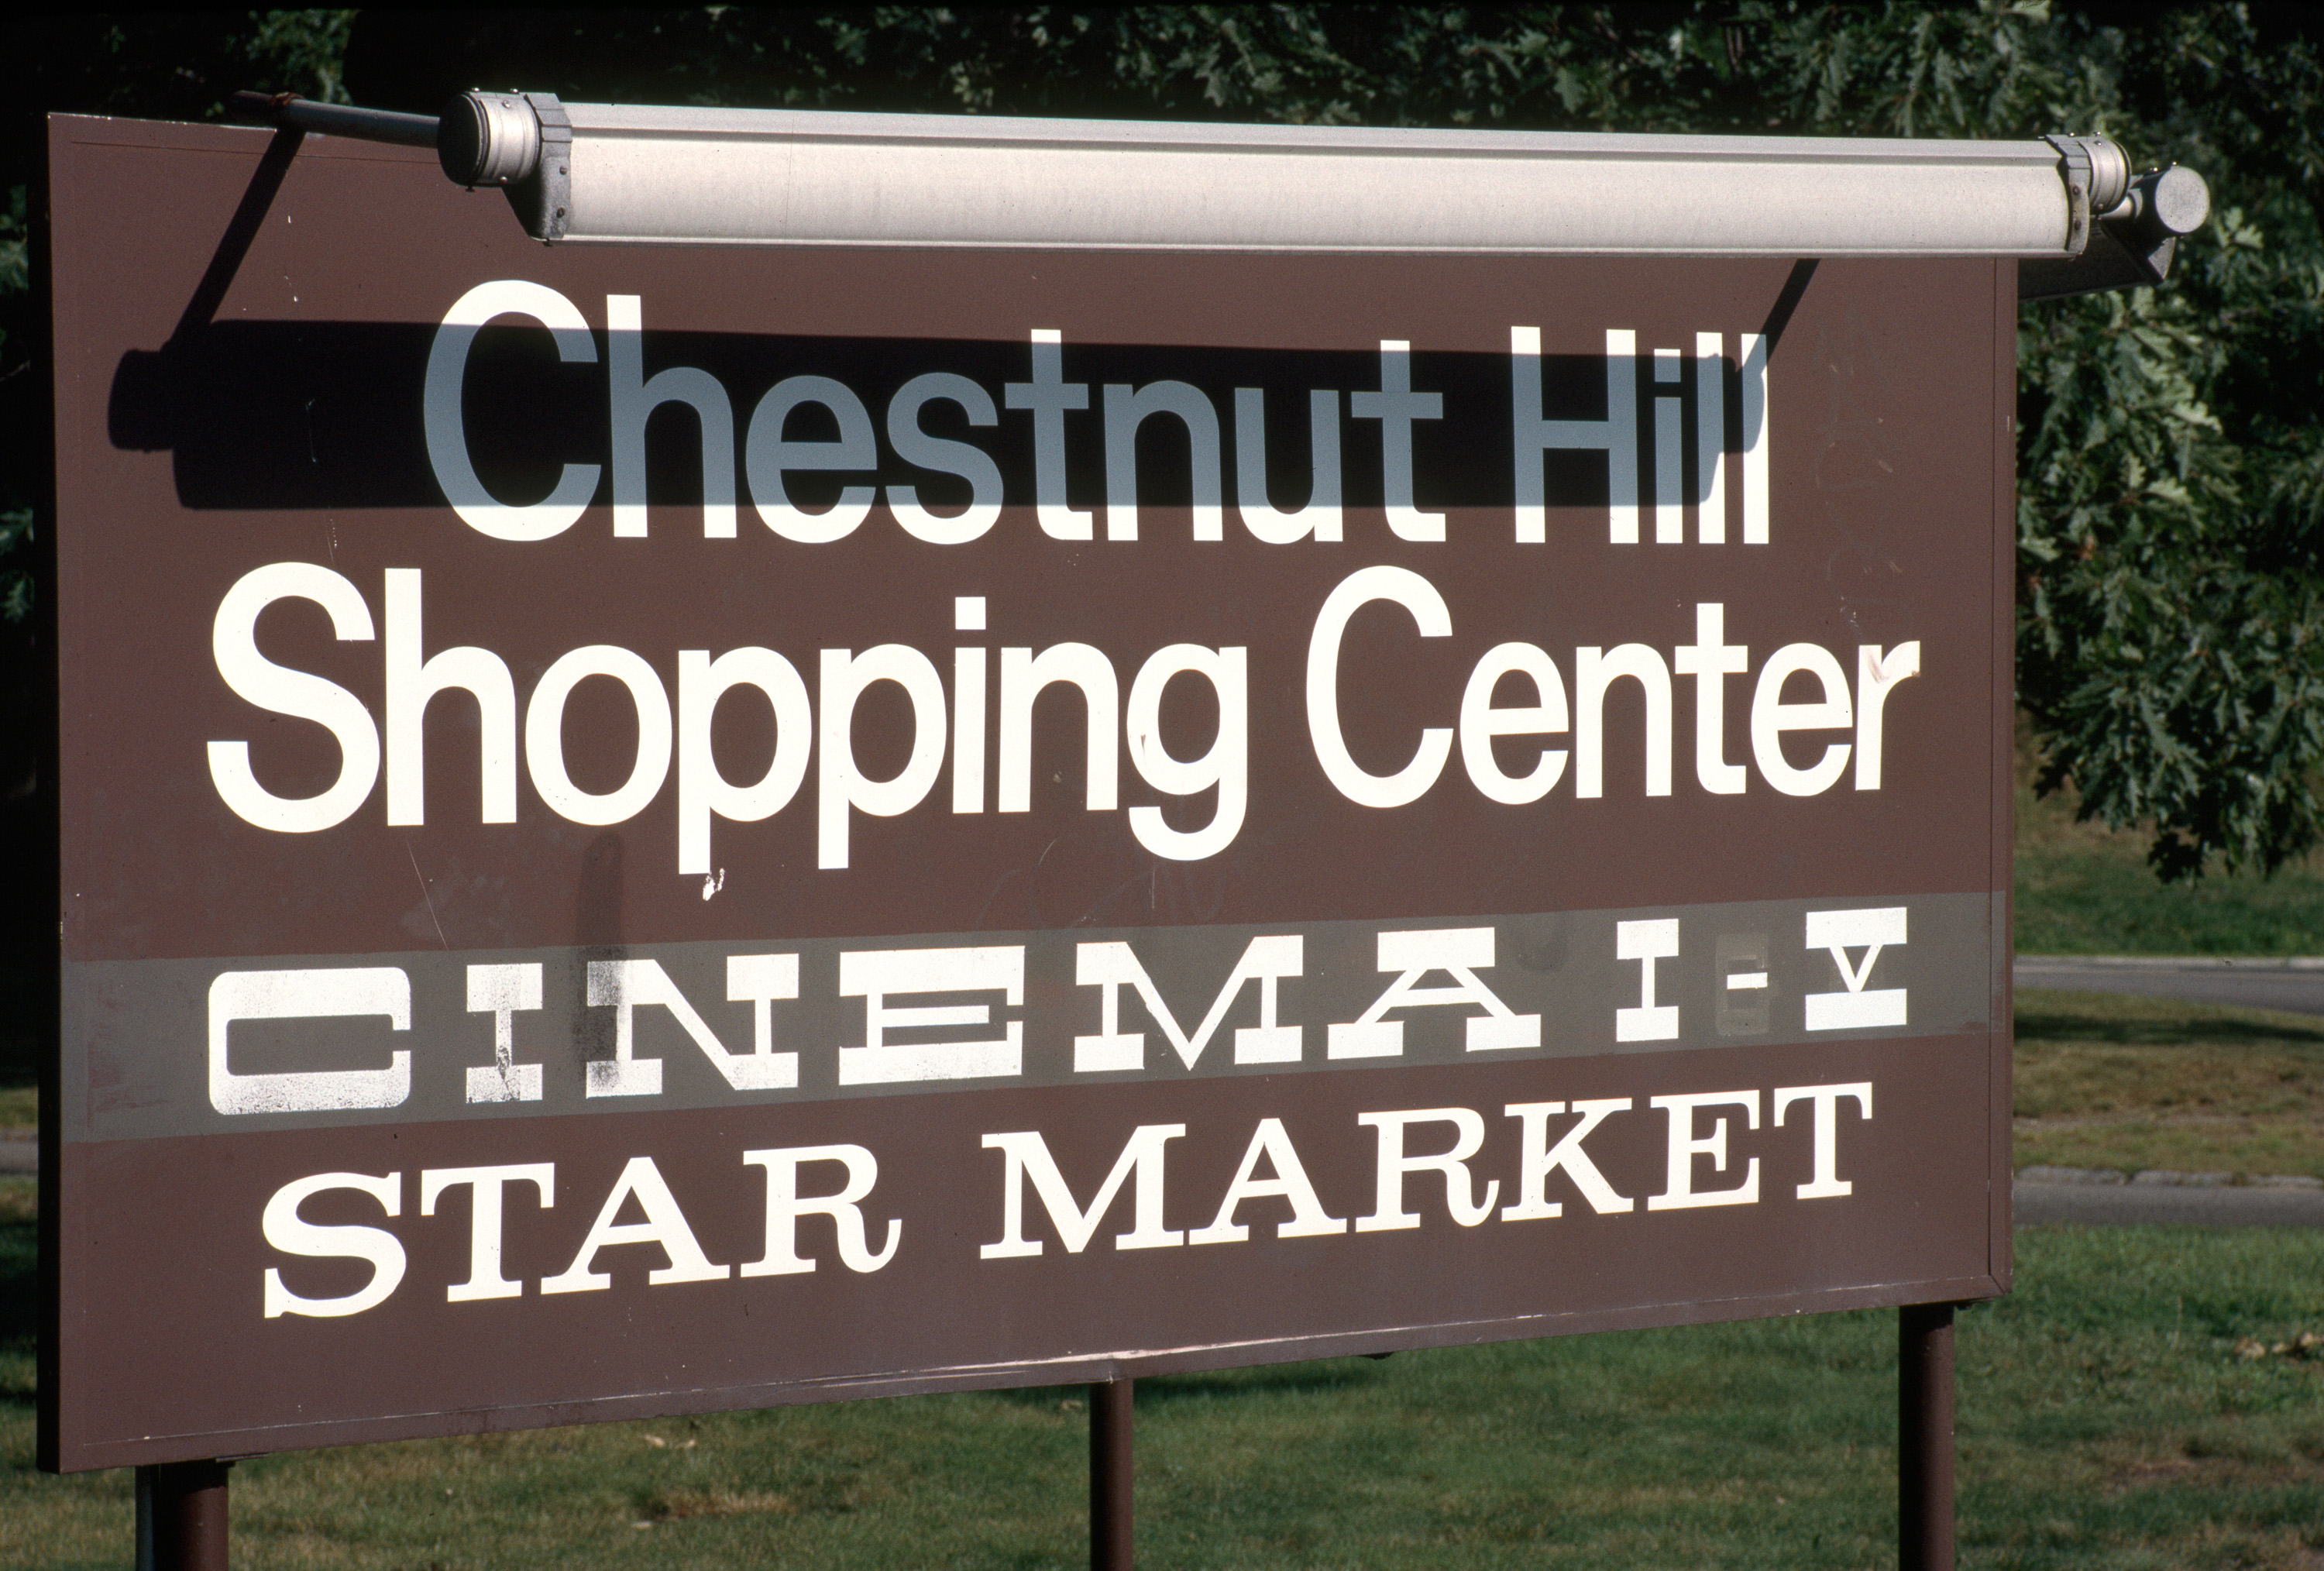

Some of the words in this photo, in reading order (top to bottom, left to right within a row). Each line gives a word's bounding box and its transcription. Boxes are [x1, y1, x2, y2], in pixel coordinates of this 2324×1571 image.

[424, 278, 1447, 547] Chestnut
[1510, 325, 1769, 547] Hill
[208, 562, 1247, 875] Shopping
[1306, 565, 1920, 808] Center
[208, 926, 1542, 1116] CINEMA
[262, 1143, 902, 1318] STAR
[980, 1081, 1872, 1260] MARKET
